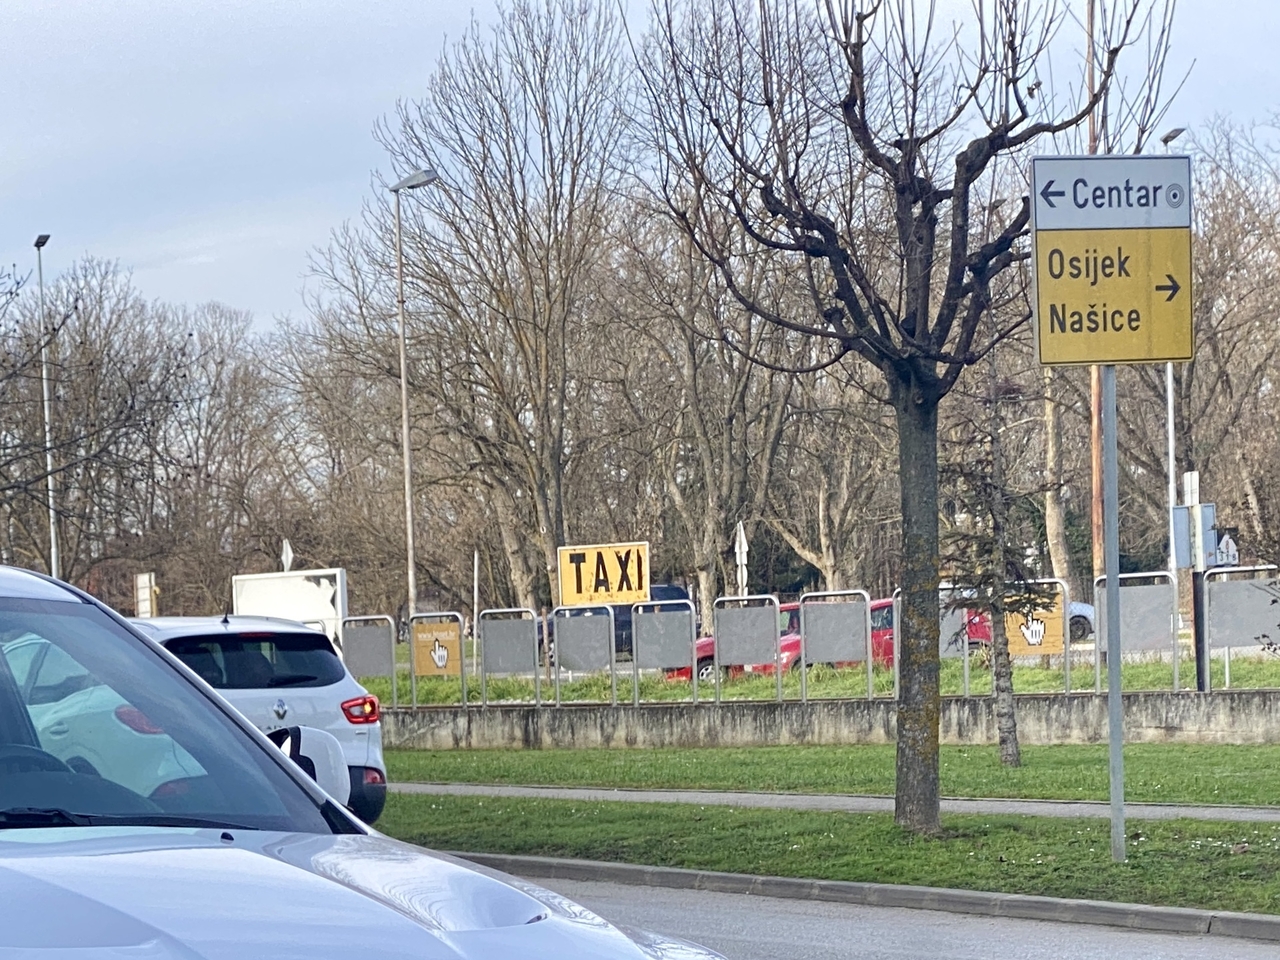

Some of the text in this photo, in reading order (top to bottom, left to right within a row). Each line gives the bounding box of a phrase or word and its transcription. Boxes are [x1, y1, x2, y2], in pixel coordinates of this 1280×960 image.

[1072, 178, 1163, 209] Centar
[1048, 246, 1131, 287] Osijek
[1049, 303, 1141, 334] Našice
[569, 548, 643, 594] TAXI
